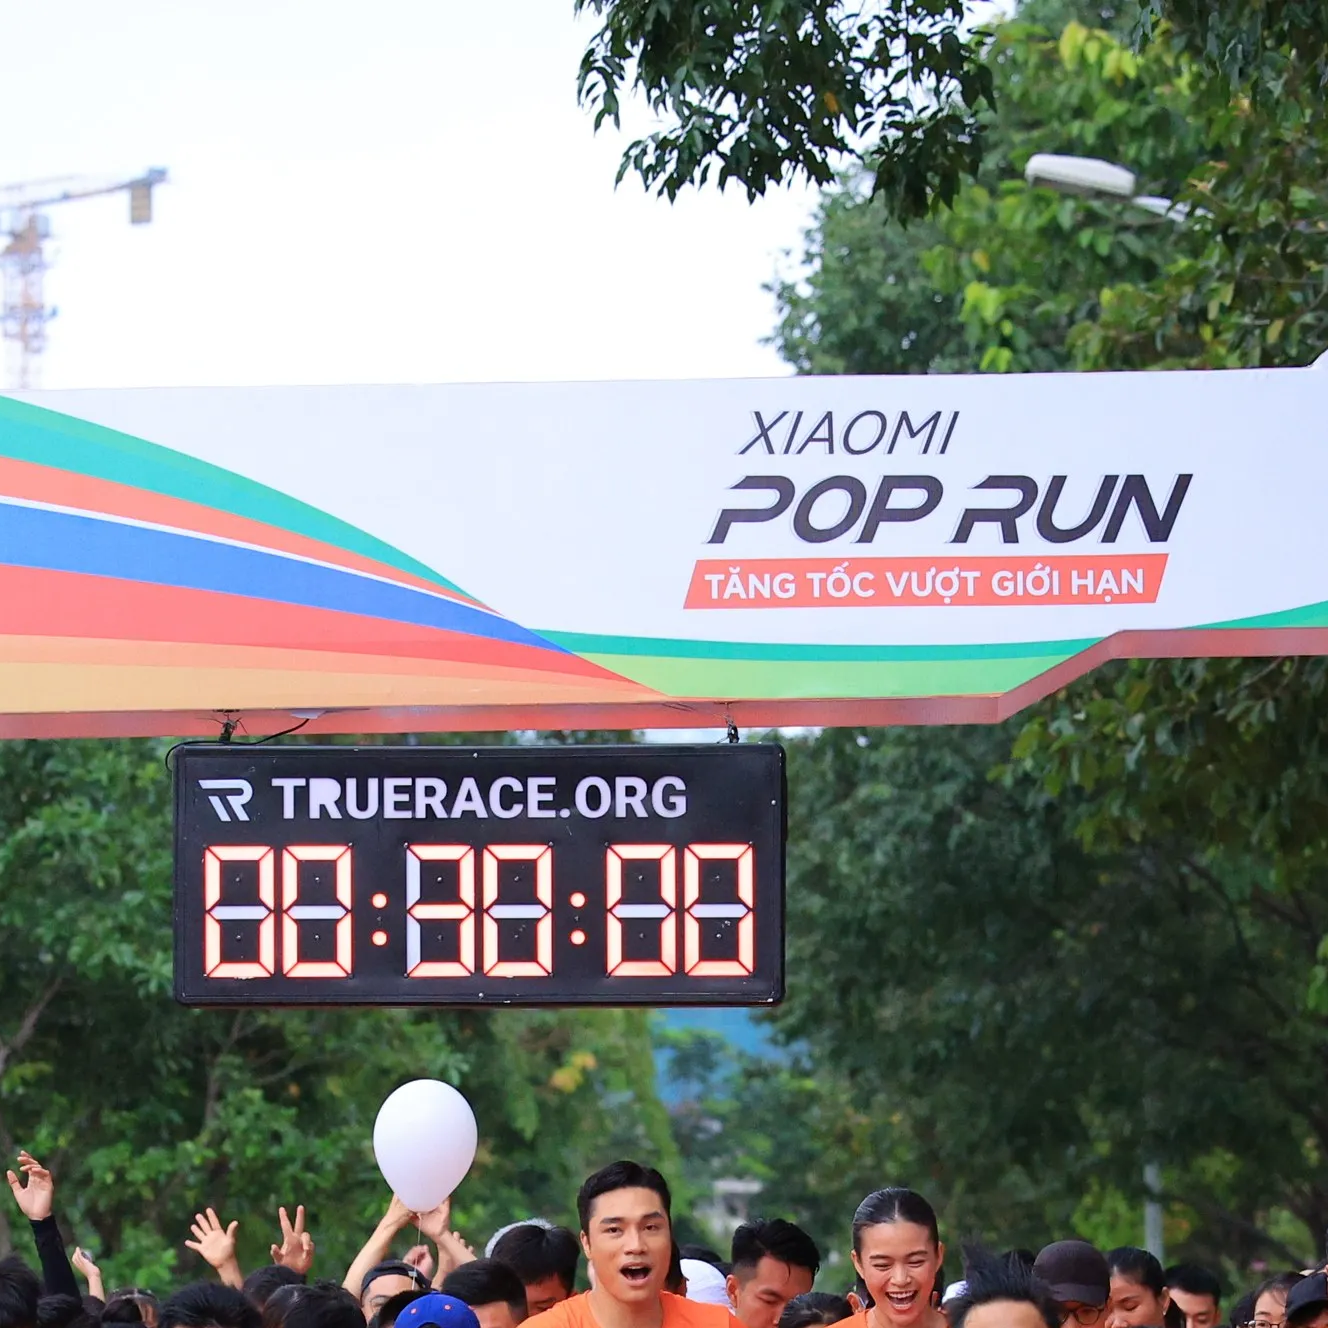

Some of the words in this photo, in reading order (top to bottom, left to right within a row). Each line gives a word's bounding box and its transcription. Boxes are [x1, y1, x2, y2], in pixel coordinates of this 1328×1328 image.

[737, 410, 960, 456] XIAOMI
[703, 474, 944, 544] POP
[947, 473, 1194, 544] RUN
[704, 564, 795, 600] TĂNG
[806, 562, 876, 598] TỐC
[886, 566, 981, 604] VƯỢT
[992, 562, 1060, 596] GIỚI
[1071, 567, 1145, 603] HẠN
[272, 776, 687, 820] TRUERACE.ORG
